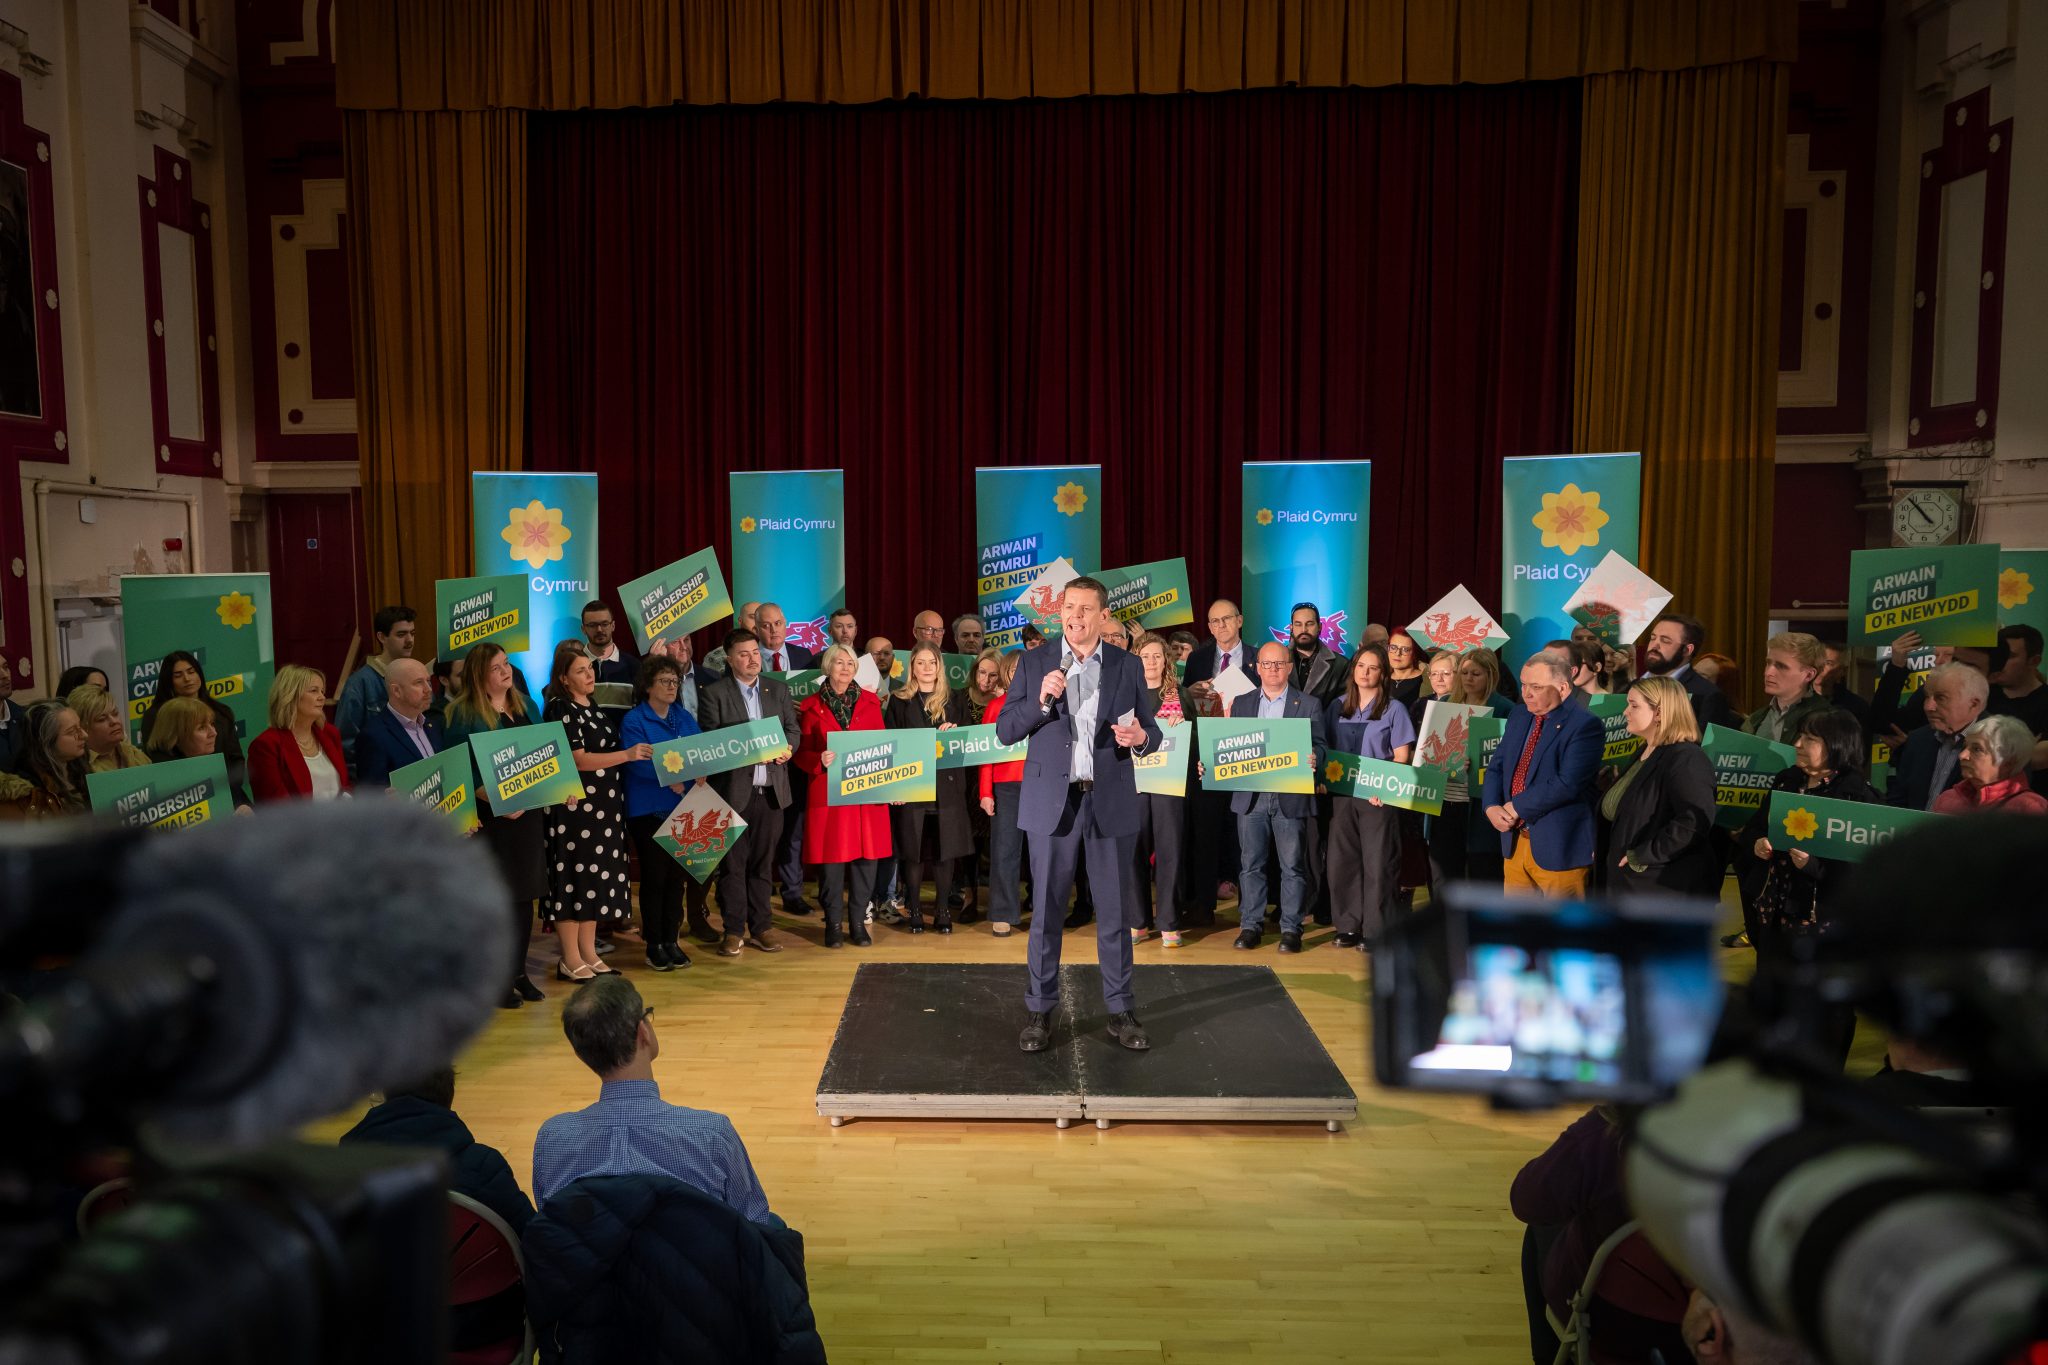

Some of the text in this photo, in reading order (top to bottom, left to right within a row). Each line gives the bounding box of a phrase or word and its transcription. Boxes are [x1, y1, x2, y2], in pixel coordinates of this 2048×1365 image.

[1901, 504, 1910, 512] 10
[1923, 493, 1932, 501] 12
[1946, 504, 1952, 512] 2
[760, 517, 836, 532] Plaid Cymru
[1277, 509, 1357, 525] Plaid Cymru
[1900, 524, 1907, 532] 8
[981, 536, 1037, 560] ARWAIN
[982, 554, 1031, 576] CYMRU
[1513, 564, 1559, 580] Plaid
[531, 576, 589, 596] Cymru
[982, 577, 1005, 592] O'R
[1107, 575, 1148, 600] ARWAIN
[1872, 565, 1936, 593] ARWAIN
[453, 591, 493, 616] ARWAIN
[640, 585, 664, 609] NEW
[645, 572, 704, 622] LEADERSHIP
[983, 599, 1014, 618] NEW
[1108, 590, 1146, 612] CYMRU
[1129, 592, 1173, 617] NEWYDD
[1872, 586, 1928, 611] CYMRU
[453, 608, 489, 631] CYMRU
[649, 589, 704, 635] FOR WALES
[1871, 595, 1970, 629] O'R NEWYDD
[454, 614, 514, 646] O'R NEWYDD
[686, 732, 780, 766] Plaid Cymru
[948, 735, 990, 755] Plaid
[1217, 731, 1265, 751] ARWAIN
[493, 746, 516, 765] NEW
[497, 744, 555, 781] LEADERSHIP
[845, 743, 892, 765] ARWAIN
[1218, 747, 1261, 764] CYMRU
[1717, 754, 1751, 769] NEW
[845, 758, 888, 779] CYMRU
[1219, 755, 1292, 778] O'R NEWYDD
[502, 762, 555, 797] FOR WALES
[846, 765, 917, 792] O'R NEWYDD
[1346, 767, 1437, 801] Plaid Cymru
[117, 787, 150, 815] NEW
[1826, 817, 1896, 846] Plaid
